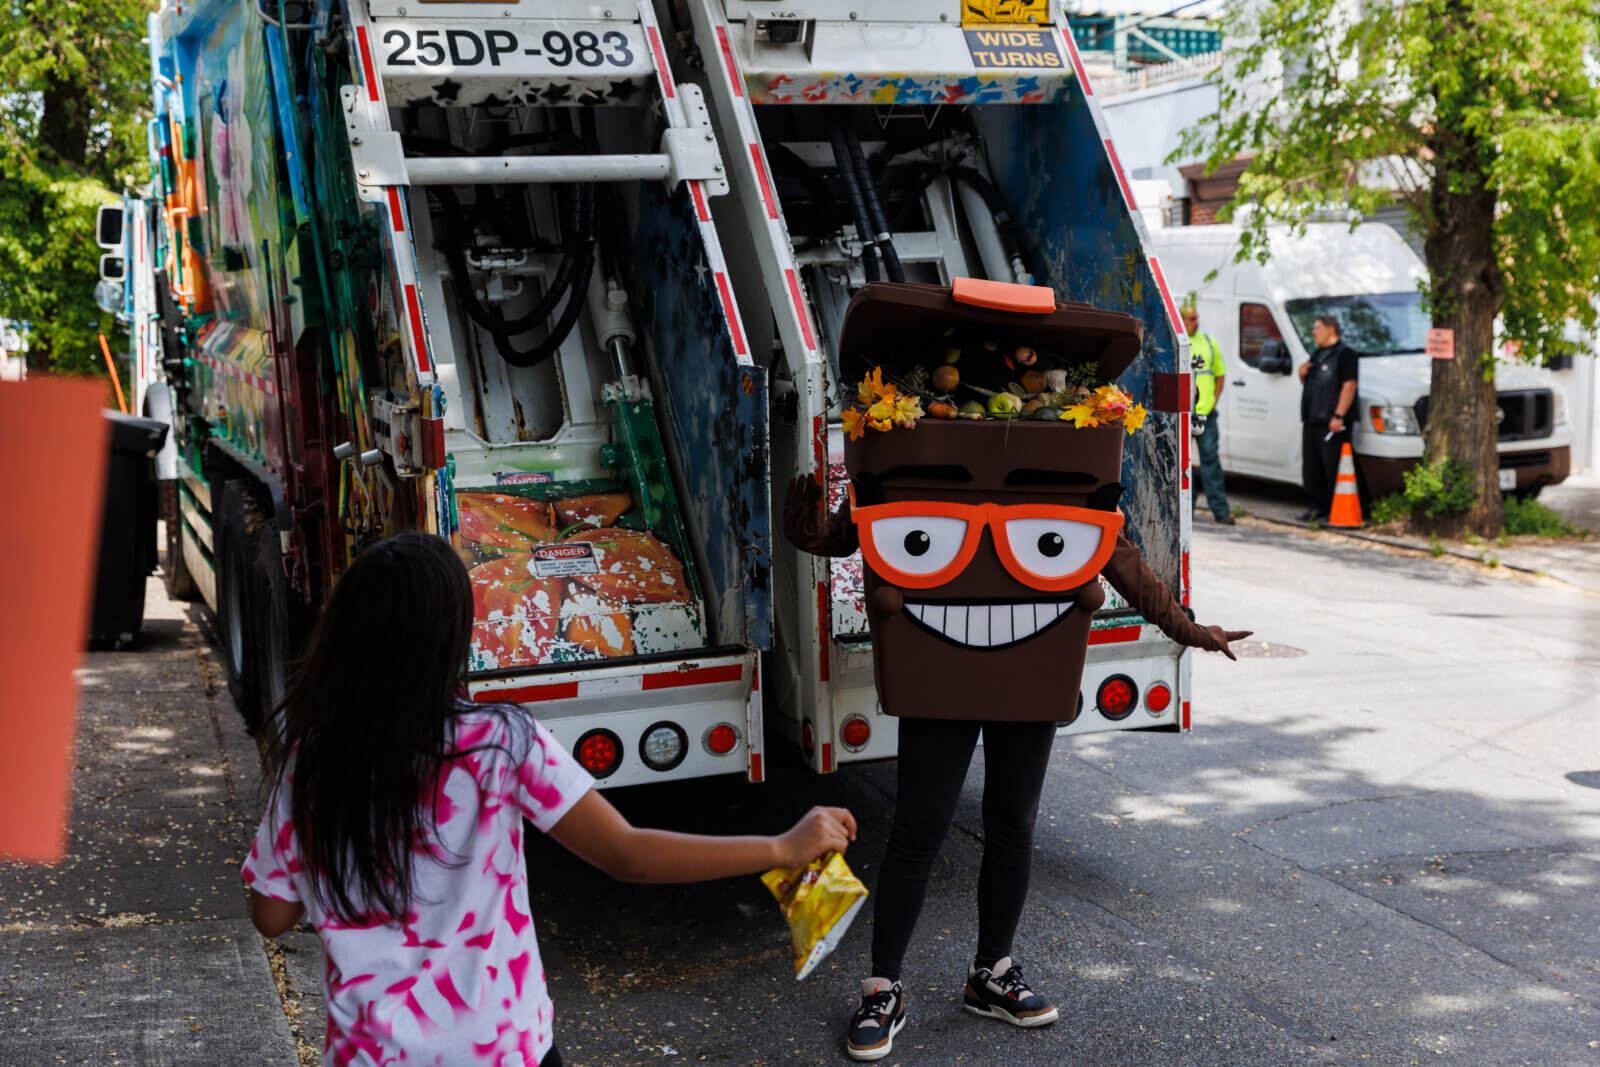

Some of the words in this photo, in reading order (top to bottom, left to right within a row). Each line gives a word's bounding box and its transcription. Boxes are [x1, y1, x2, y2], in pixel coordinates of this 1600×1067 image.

[976, 31, 1044, 47] WIDE
[383, 30, 634, 67] 25DP-983
[973, 51, 1060, 67] TURNS
[539, 547, 585, 558] DANGER
